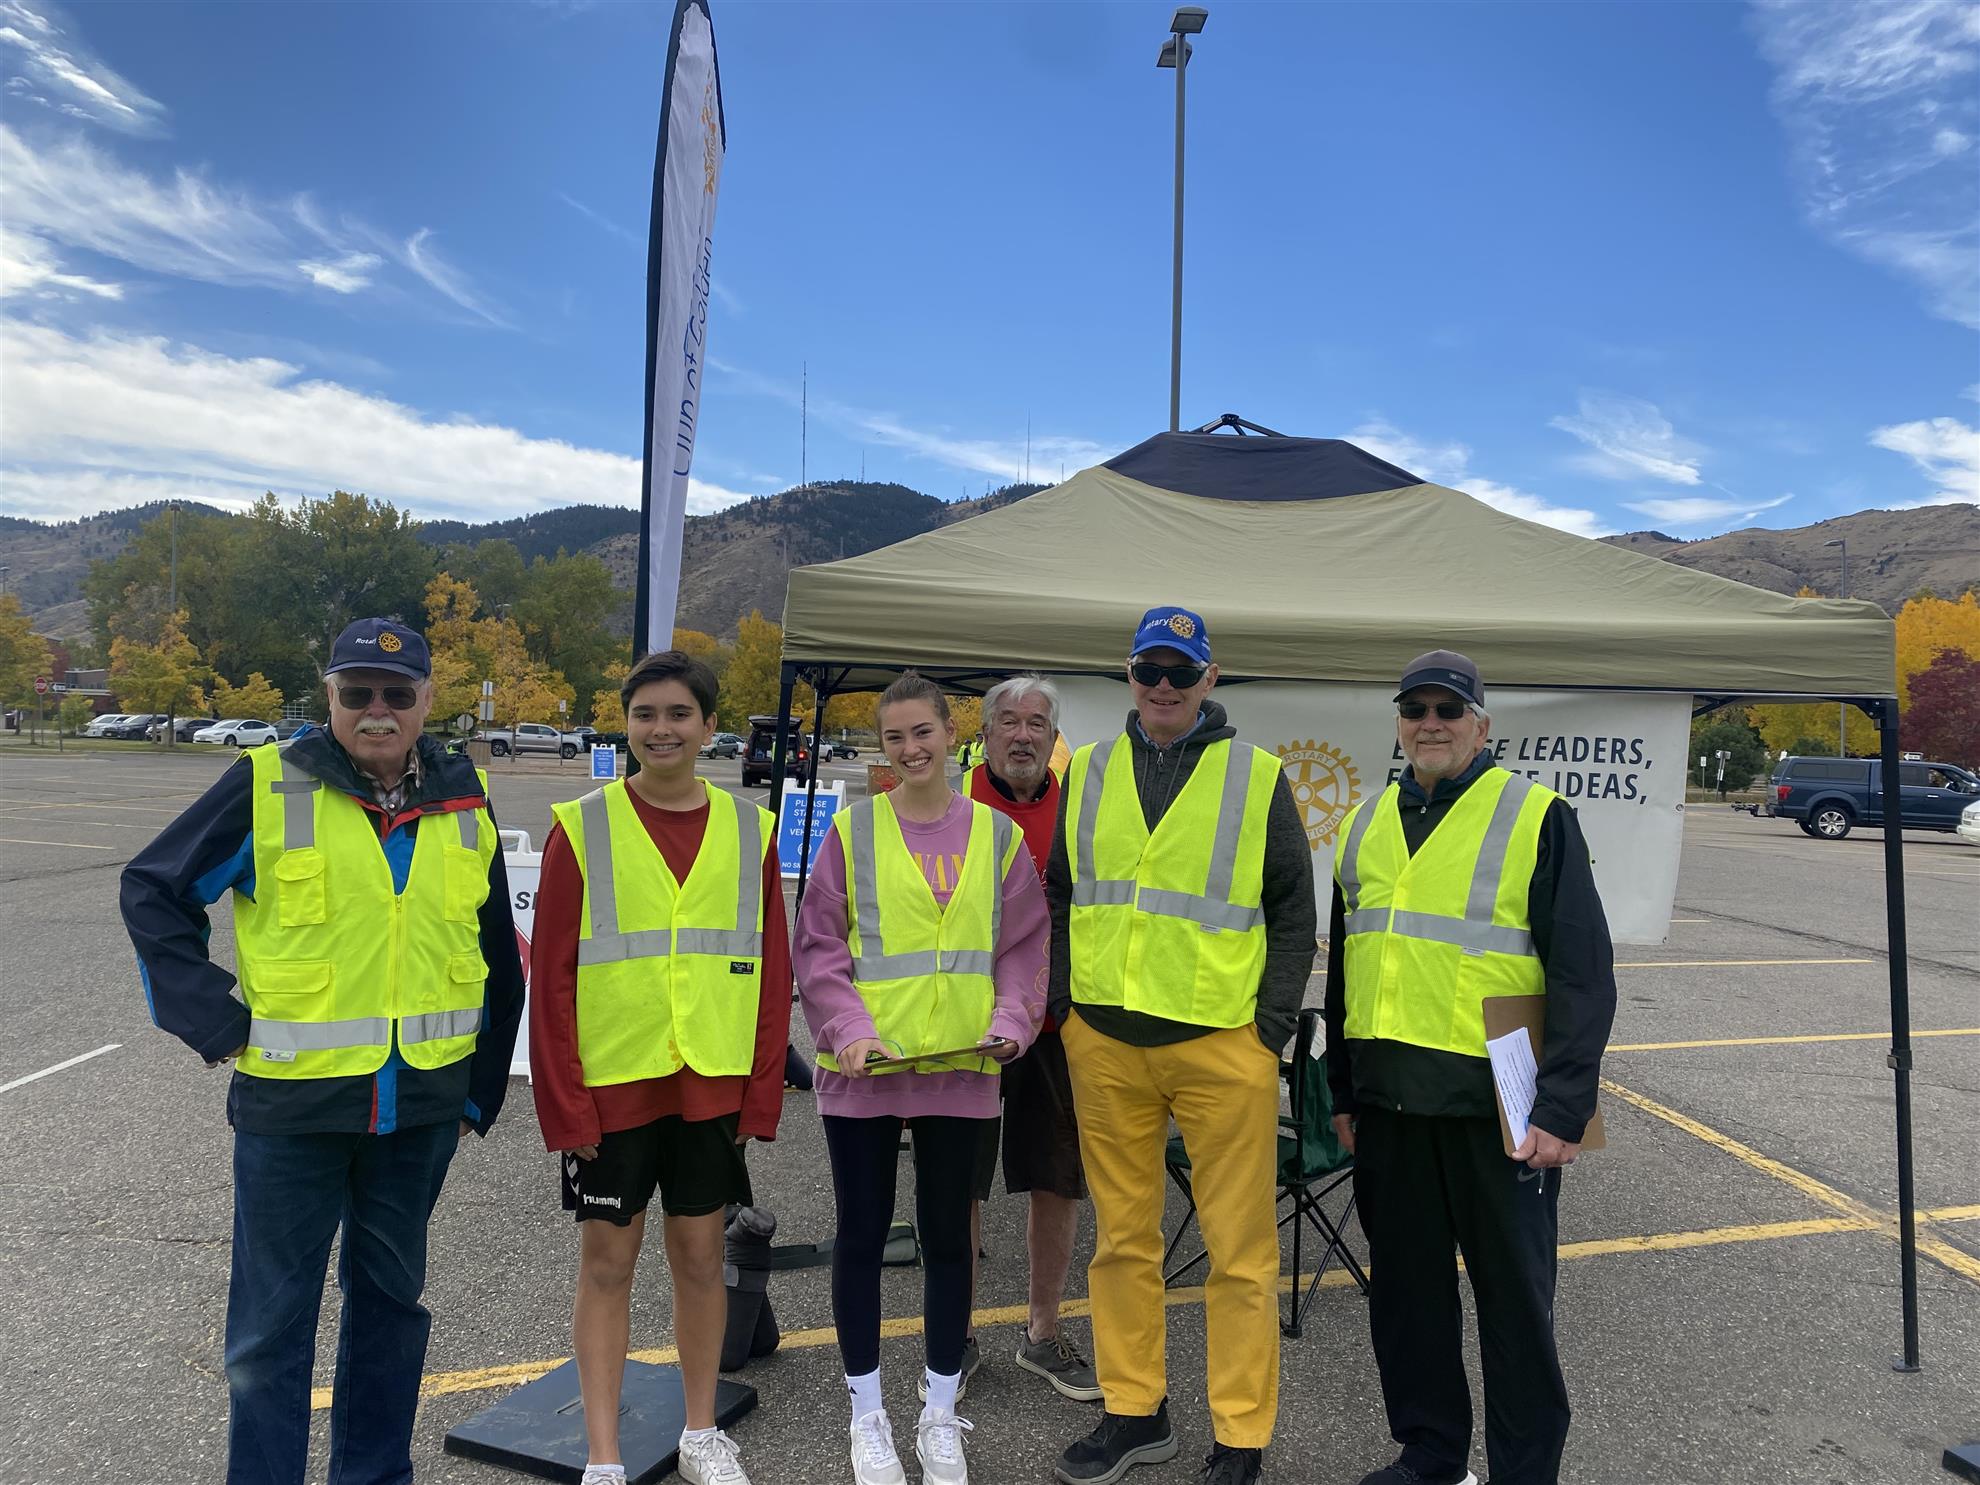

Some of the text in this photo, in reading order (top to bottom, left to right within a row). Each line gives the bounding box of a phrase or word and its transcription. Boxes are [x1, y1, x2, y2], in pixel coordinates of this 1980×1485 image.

[1283, 751, 1332, 763] ROTARY
[1518, 736, 1653, 769] LEADERS,
[1554, 771, 1647, 804] IDEAS,
